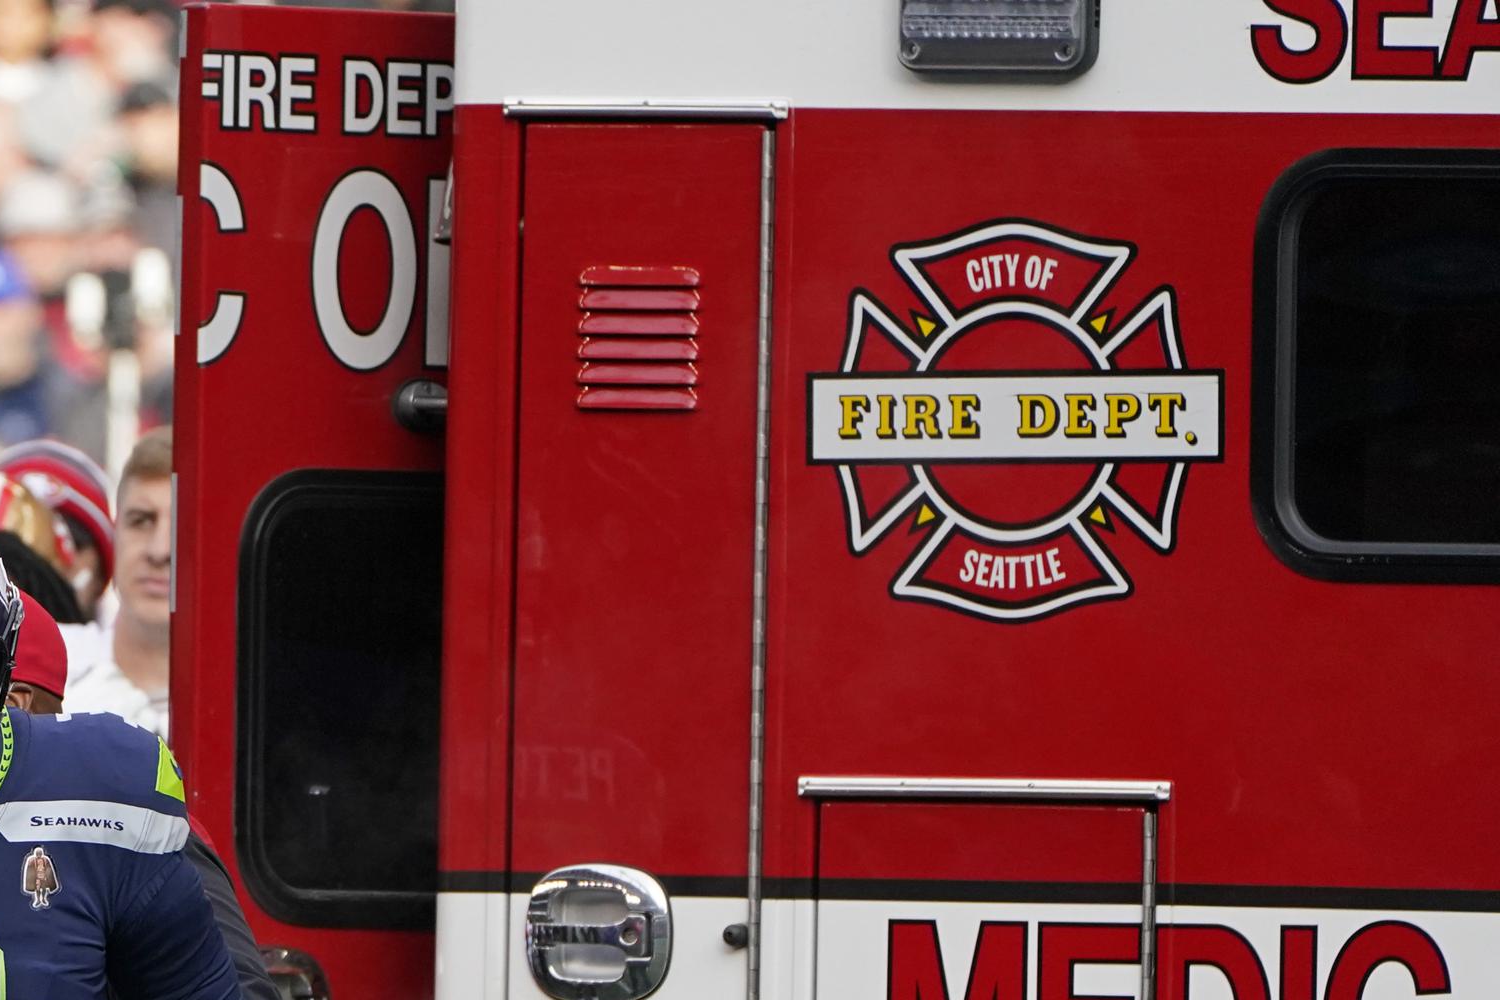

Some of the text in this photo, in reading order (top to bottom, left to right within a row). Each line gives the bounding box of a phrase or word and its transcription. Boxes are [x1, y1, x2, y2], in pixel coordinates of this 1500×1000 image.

[965, 253, 1058, 293] CITY OF
[838, 392, 1198, 446] FIRE DEPT.
[959, 547, 1067, 589] SEATTLE
[30, 815, 125, 832] SEAHAWKS
